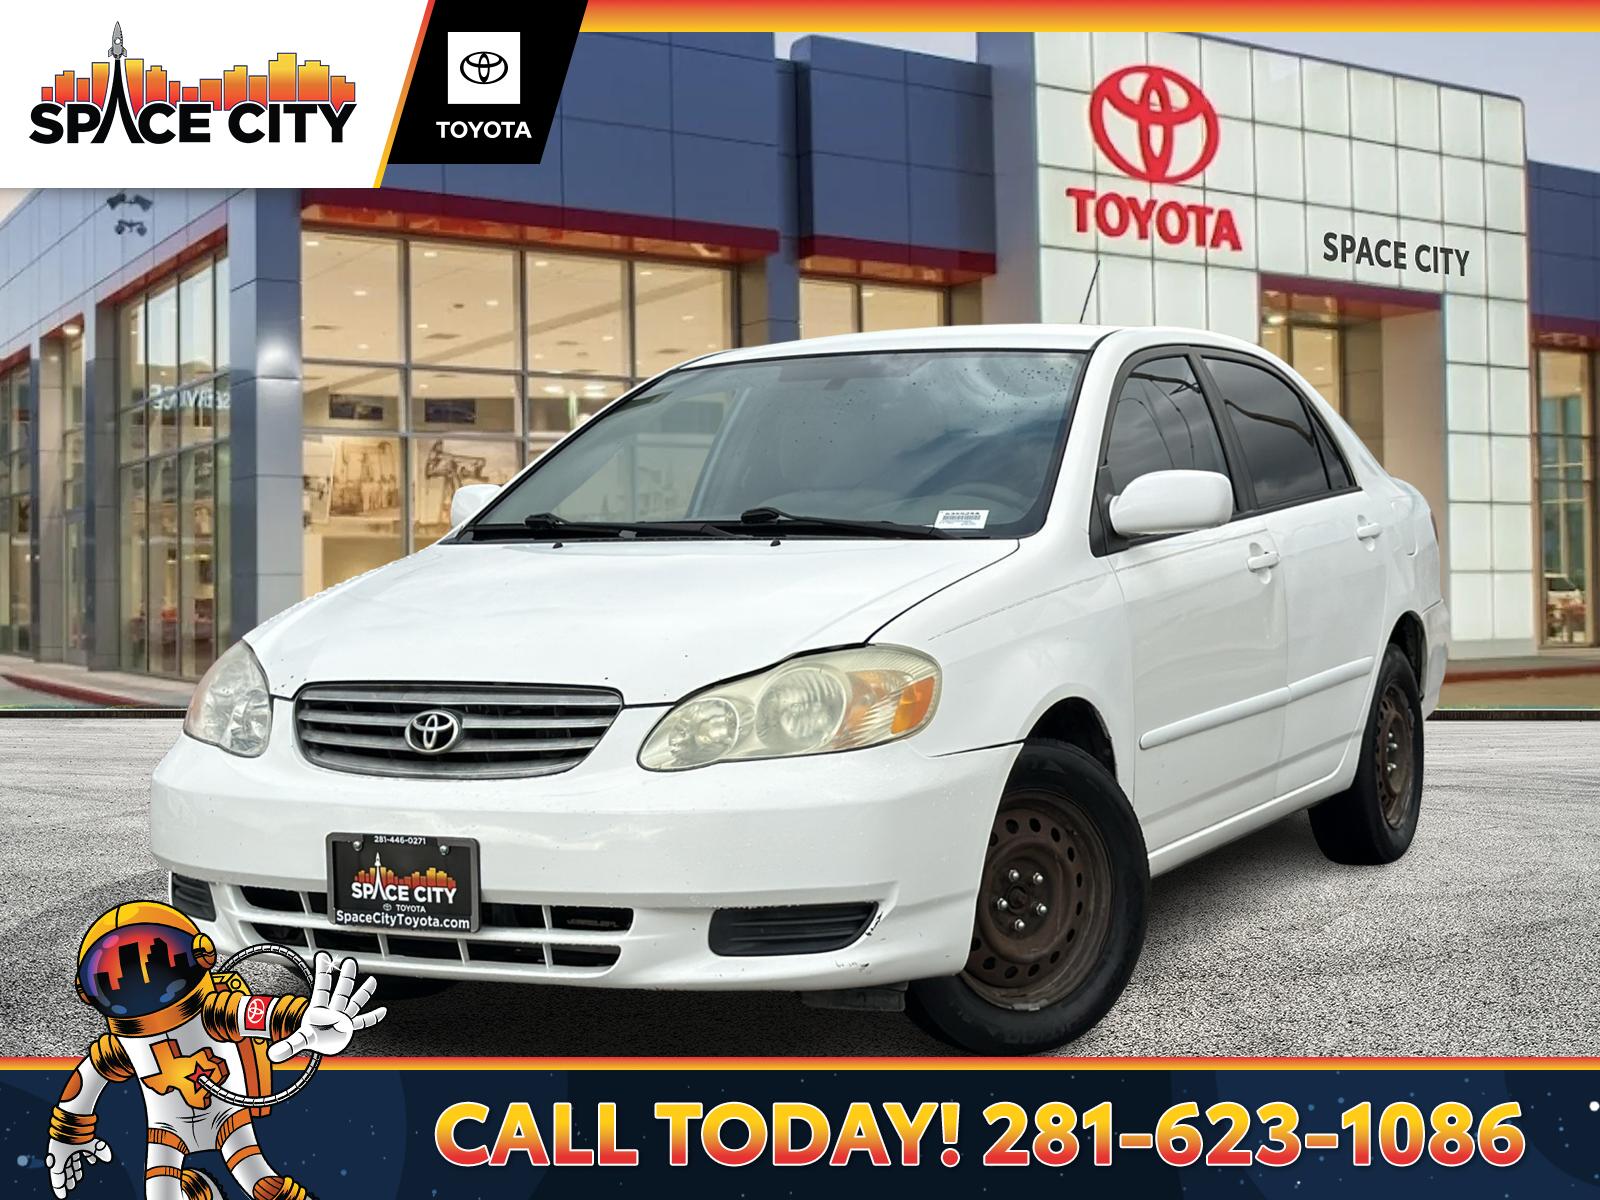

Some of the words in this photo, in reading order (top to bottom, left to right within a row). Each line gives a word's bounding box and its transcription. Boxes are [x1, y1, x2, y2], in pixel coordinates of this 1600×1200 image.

[1066, 188, 1242, 251] TOYOTA
[1323, 232, 1406, 270] SPACE
[1415, 244, 1470, 277] CITY
[374, 835, 426, 844] 281-446-0271
[351, 882, 410, 902] SPACE
[413, 886, 457, 904] CITY
[396, 904, 426, 912] TOYOTA
[336, 910, 470, 928] SpaceCityToyota.com
